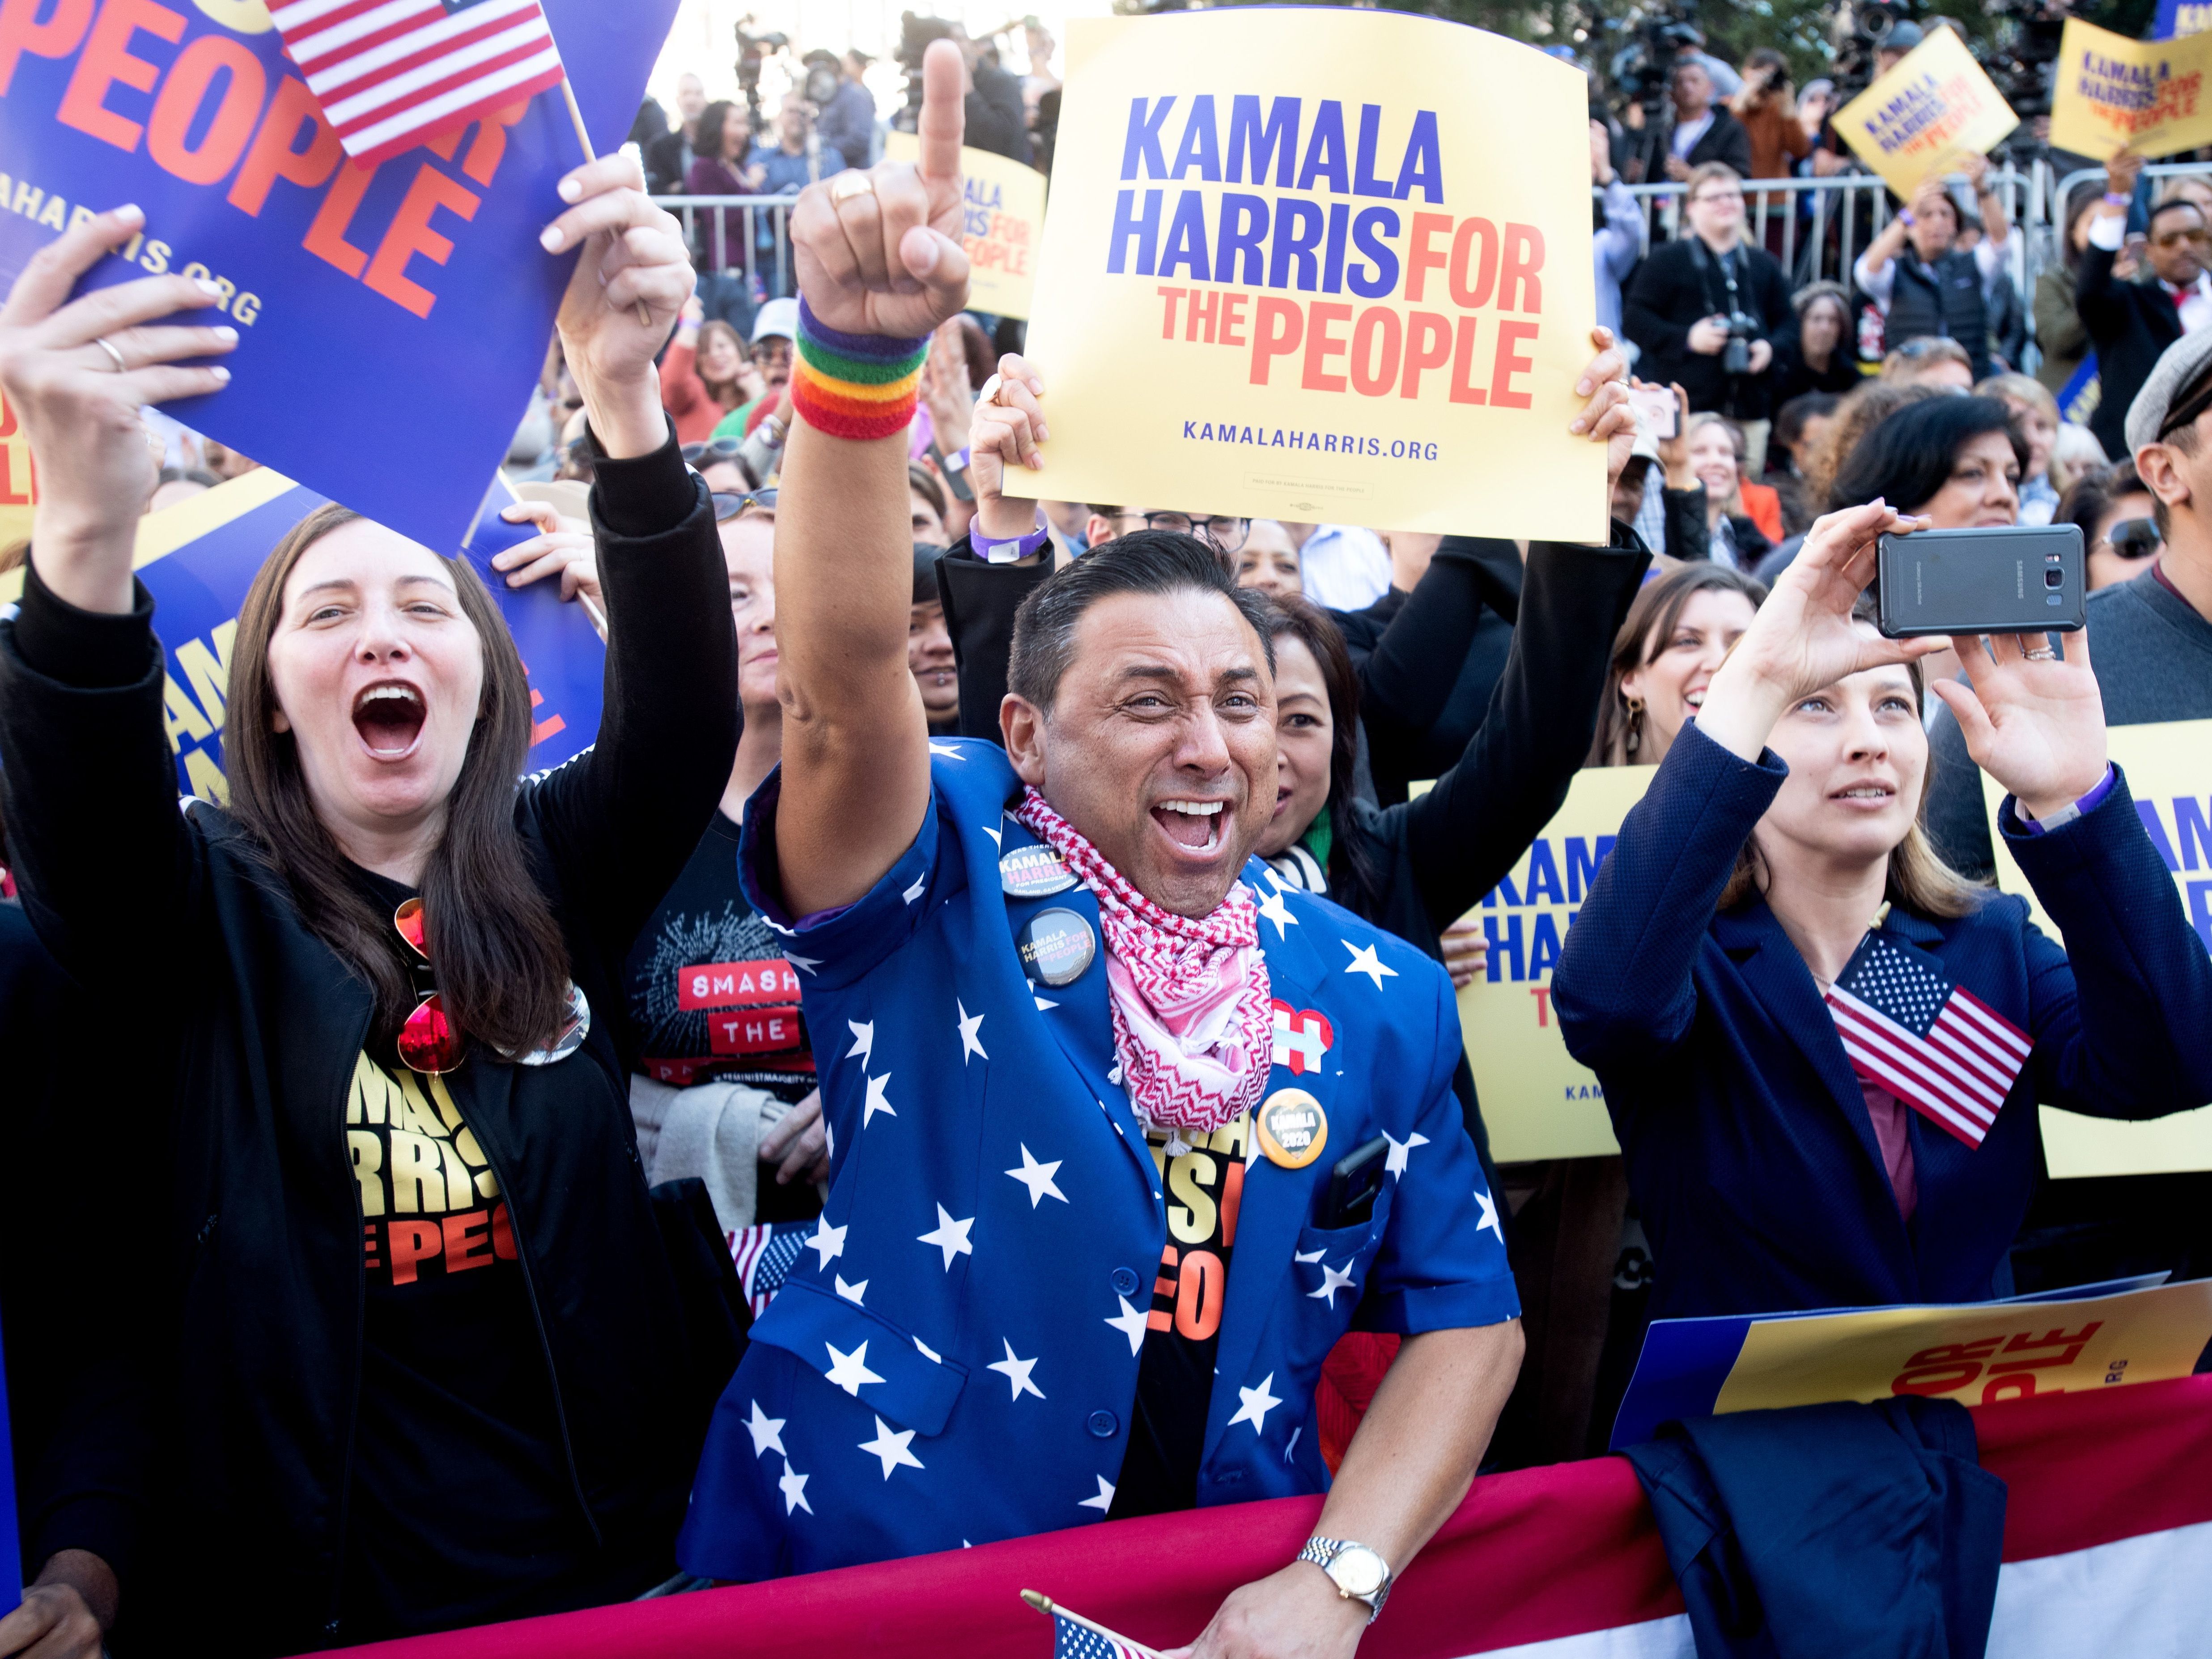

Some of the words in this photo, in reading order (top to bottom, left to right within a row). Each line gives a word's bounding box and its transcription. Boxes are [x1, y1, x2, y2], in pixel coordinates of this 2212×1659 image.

[1120, 94, 1445, 205] KAMALA
[1106, 188, 1401, 300] HARRIS
[1404, 211, 1545, 314] FOR
[1157, 286, 1248, 347] THE
[1249, 295, 1540, 410] PEOPLE
[1183, 421, 1438, 461] KAMALAHARRIS.ORG
[1007, 861, 1072, 885] HARRIS
[1031, 874, 1068, 885] PRESIDENT
[1021, 929, 1067, 955] KAMALA
[1024, 940, 1065, 963] HARRIS
[1065, 930, 1089, 945] FOR
[1049, 938, 1092, 962] PEOPLE
[692, 969, 799, 999] SMASH
[722, 1018, 786, 1043] THE
[1270, 1111, 1316, 1131] KAMALA
[1281, 1130, 1312, 1149] 2020
